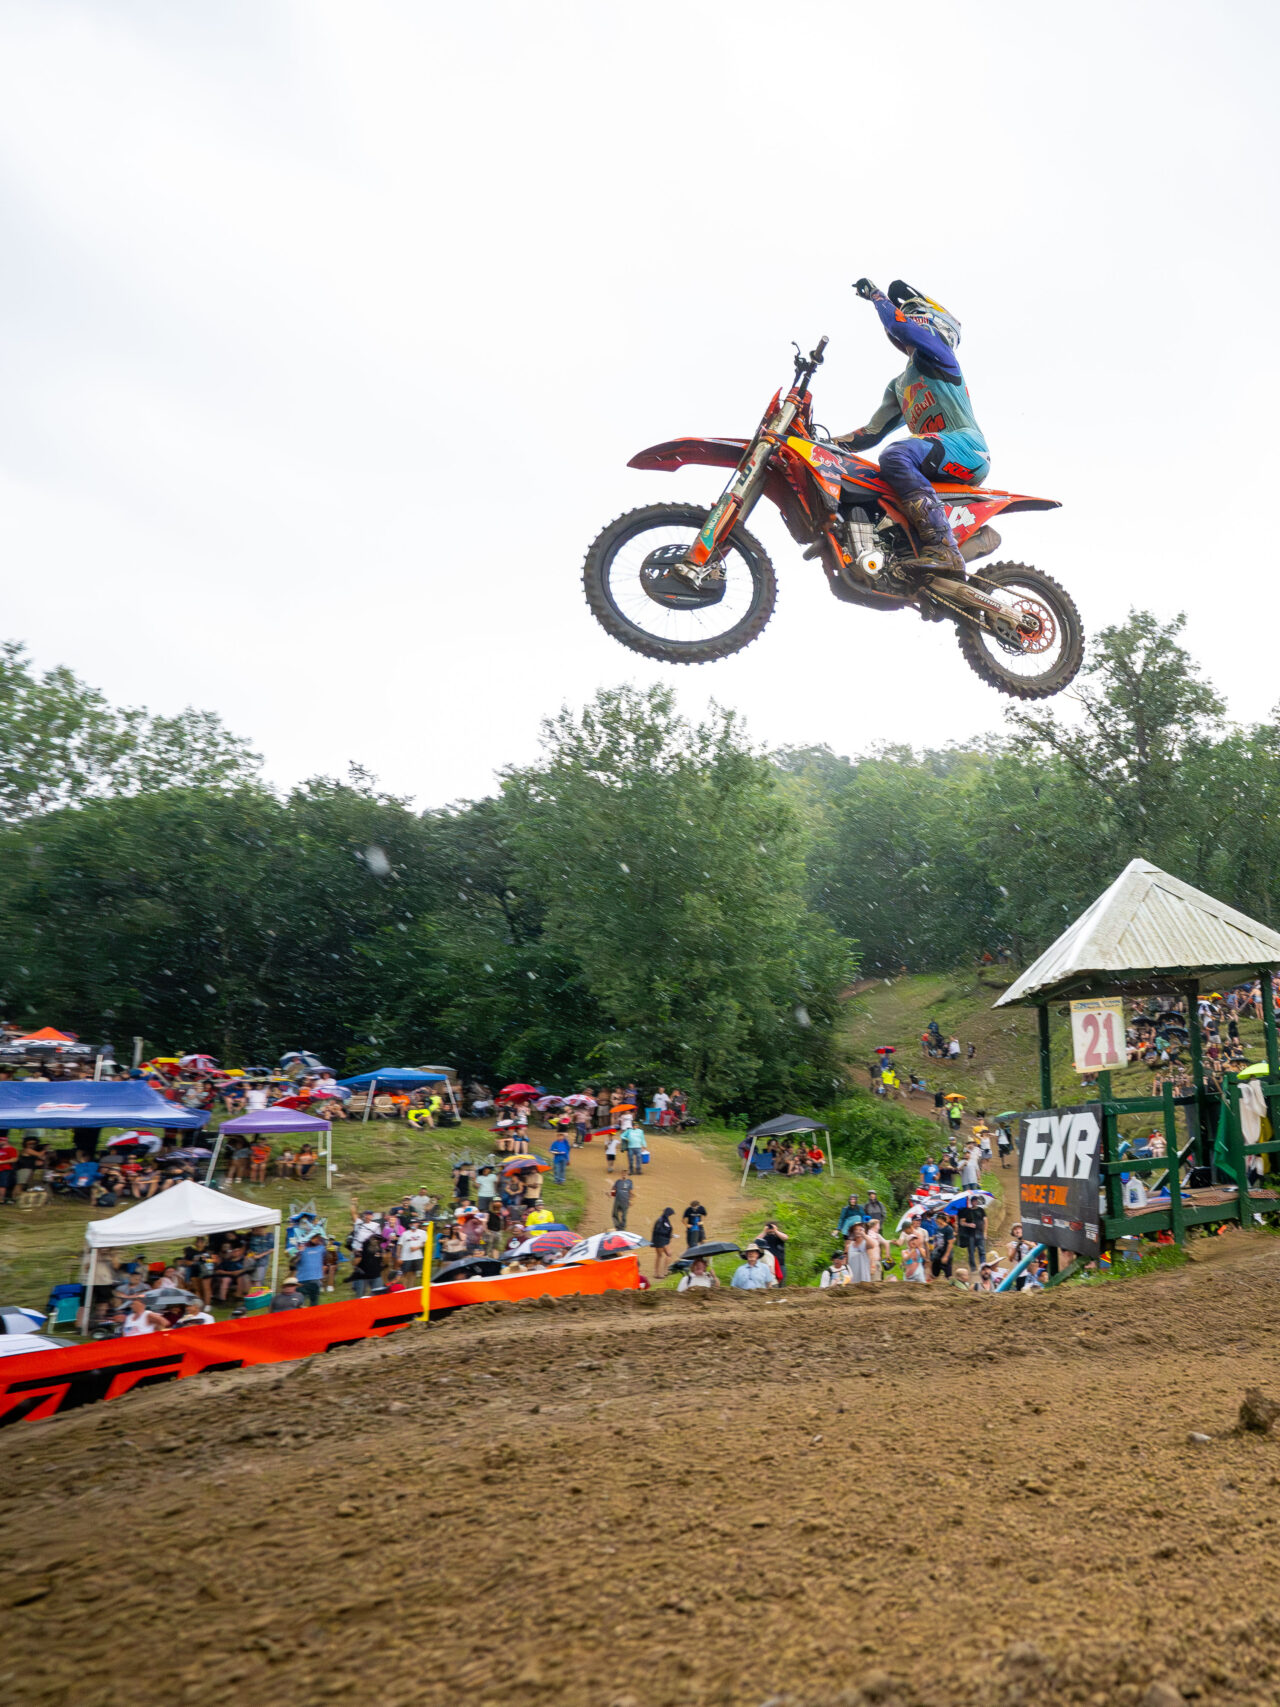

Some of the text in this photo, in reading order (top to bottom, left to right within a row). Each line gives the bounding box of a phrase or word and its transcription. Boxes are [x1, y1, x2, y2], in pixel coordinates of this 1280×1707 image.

[971, 591, 1001, 610] ENTHAL
[1081, 1013, 1120, 1067] 21
[1020, 1111, 1100, 1180] FXR
